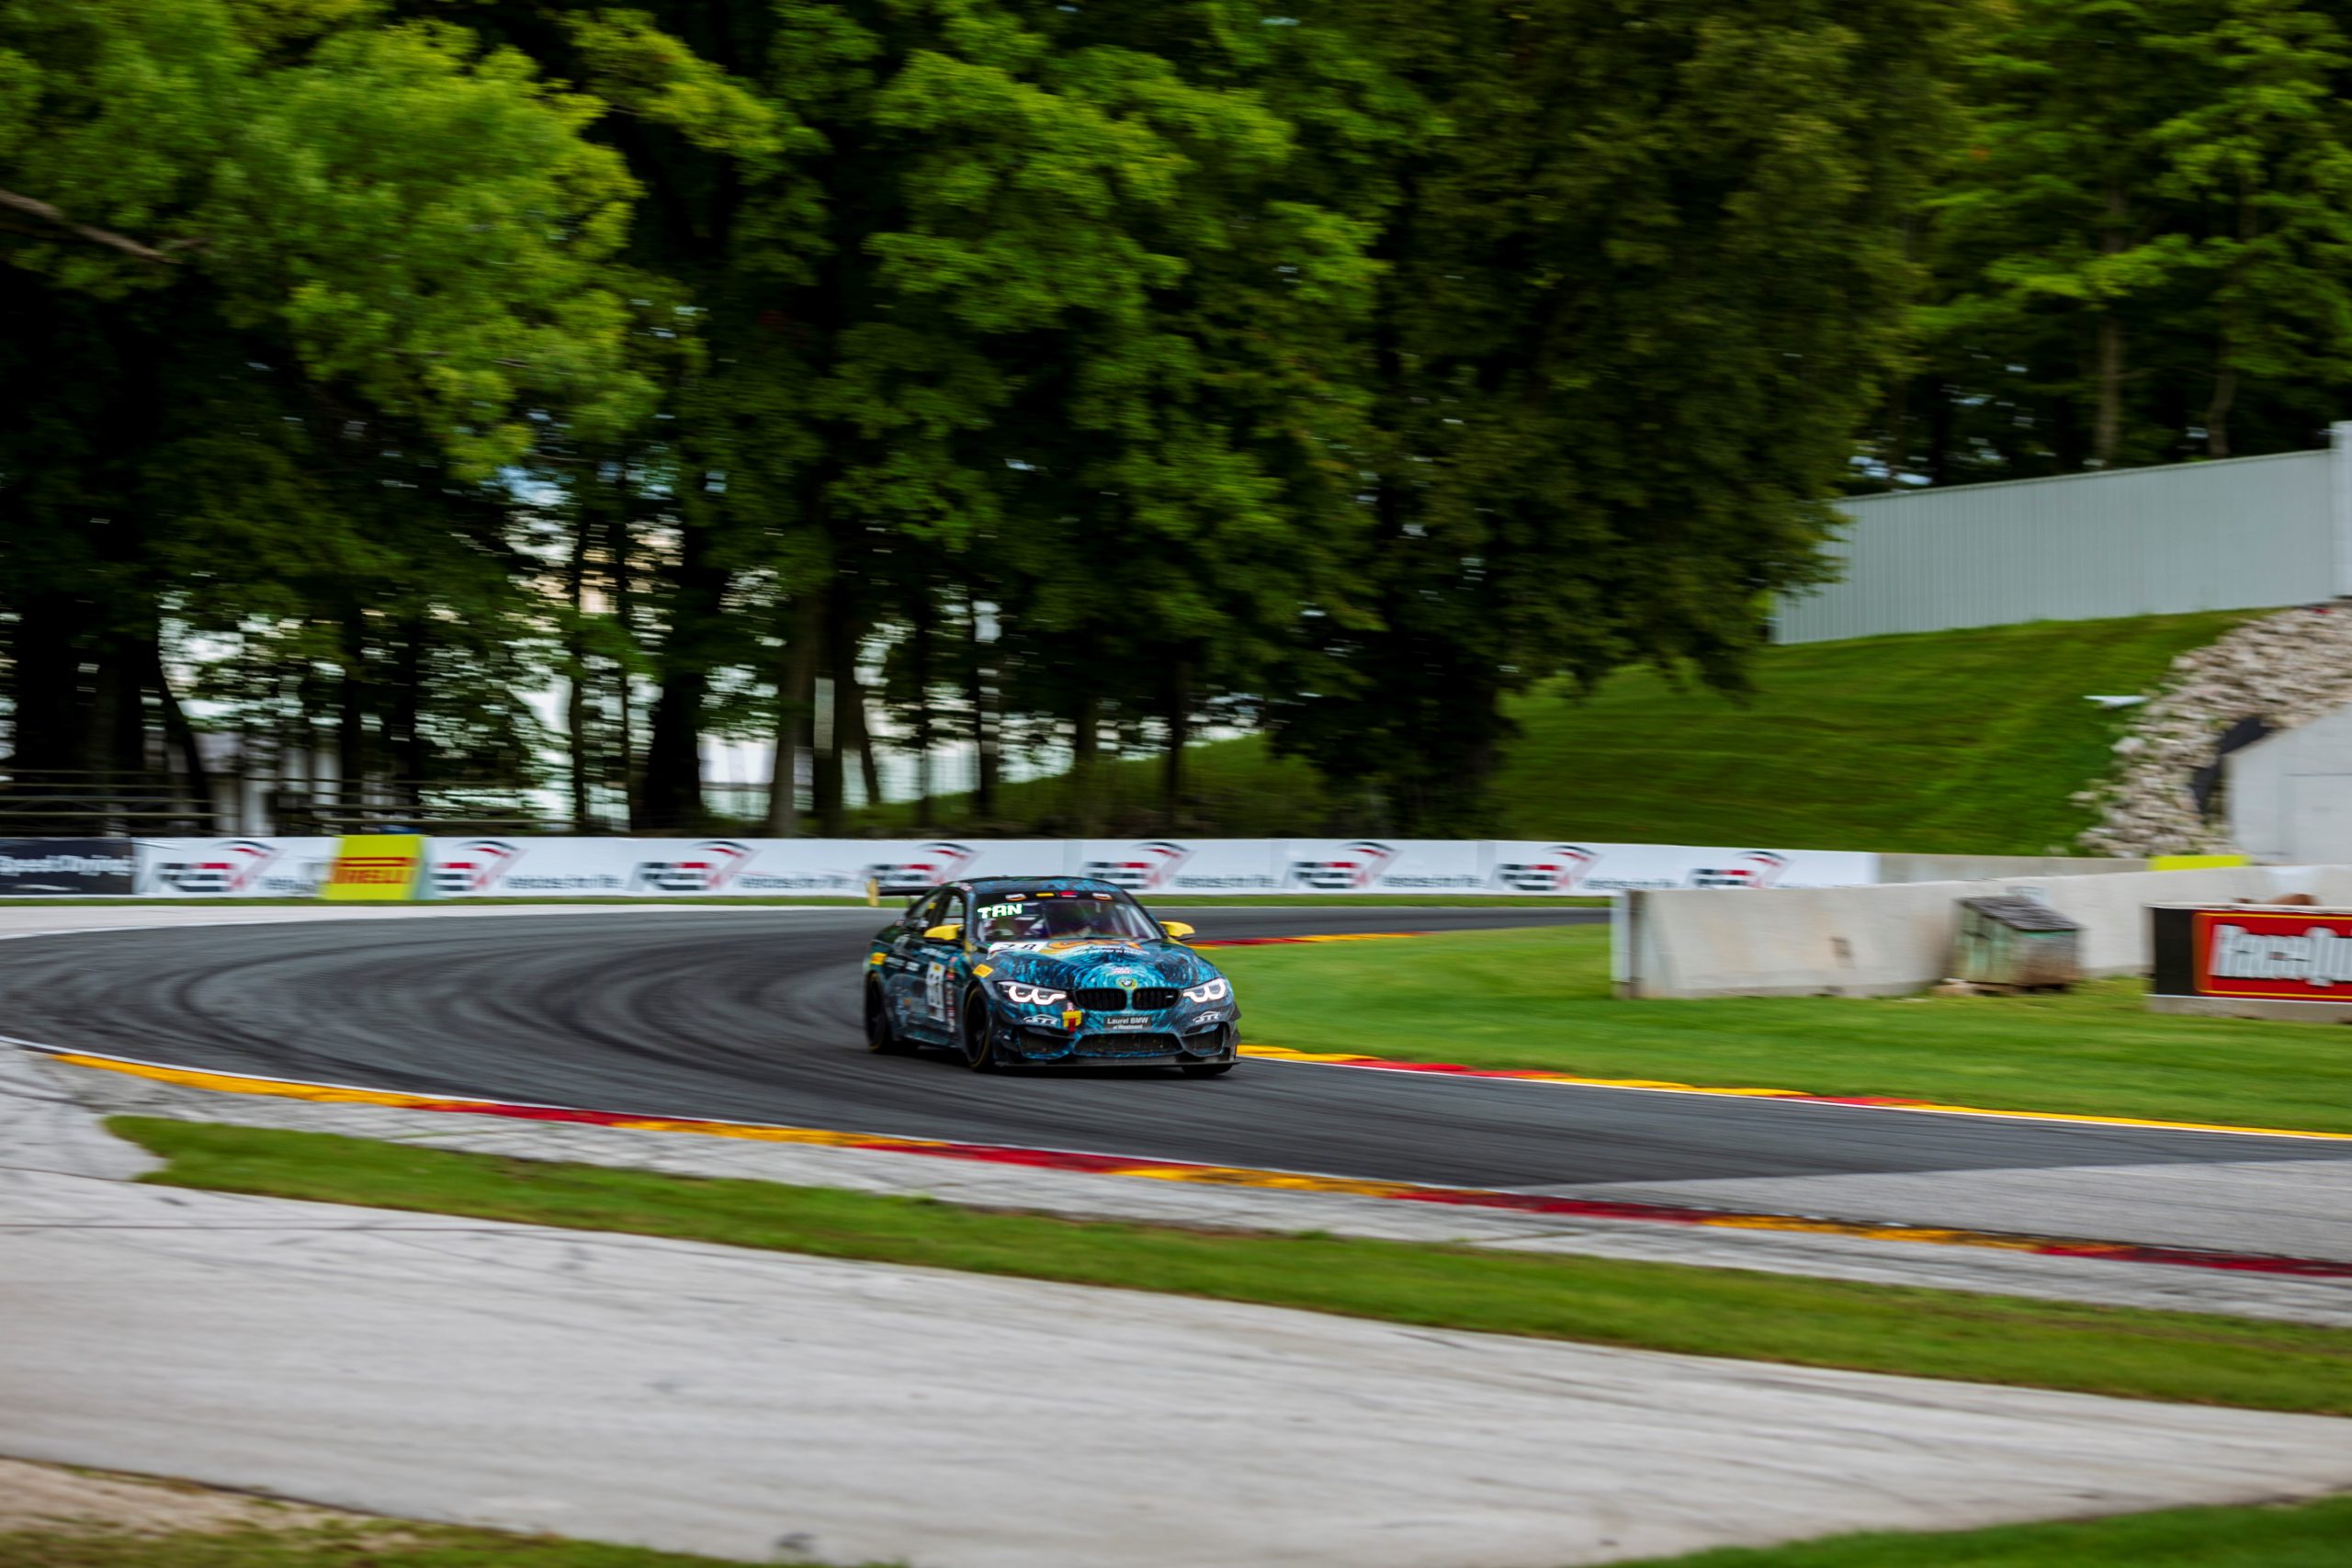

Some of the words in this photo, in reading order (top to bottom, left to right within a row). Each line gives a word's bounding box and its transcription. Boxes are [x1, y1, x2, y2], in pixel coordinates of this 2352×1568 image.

[978, 904, 1023, 919] TAN
[1107, 1017, 1129, 1025] Laurel
[1130, 1016, 1148, 1024] BMW
